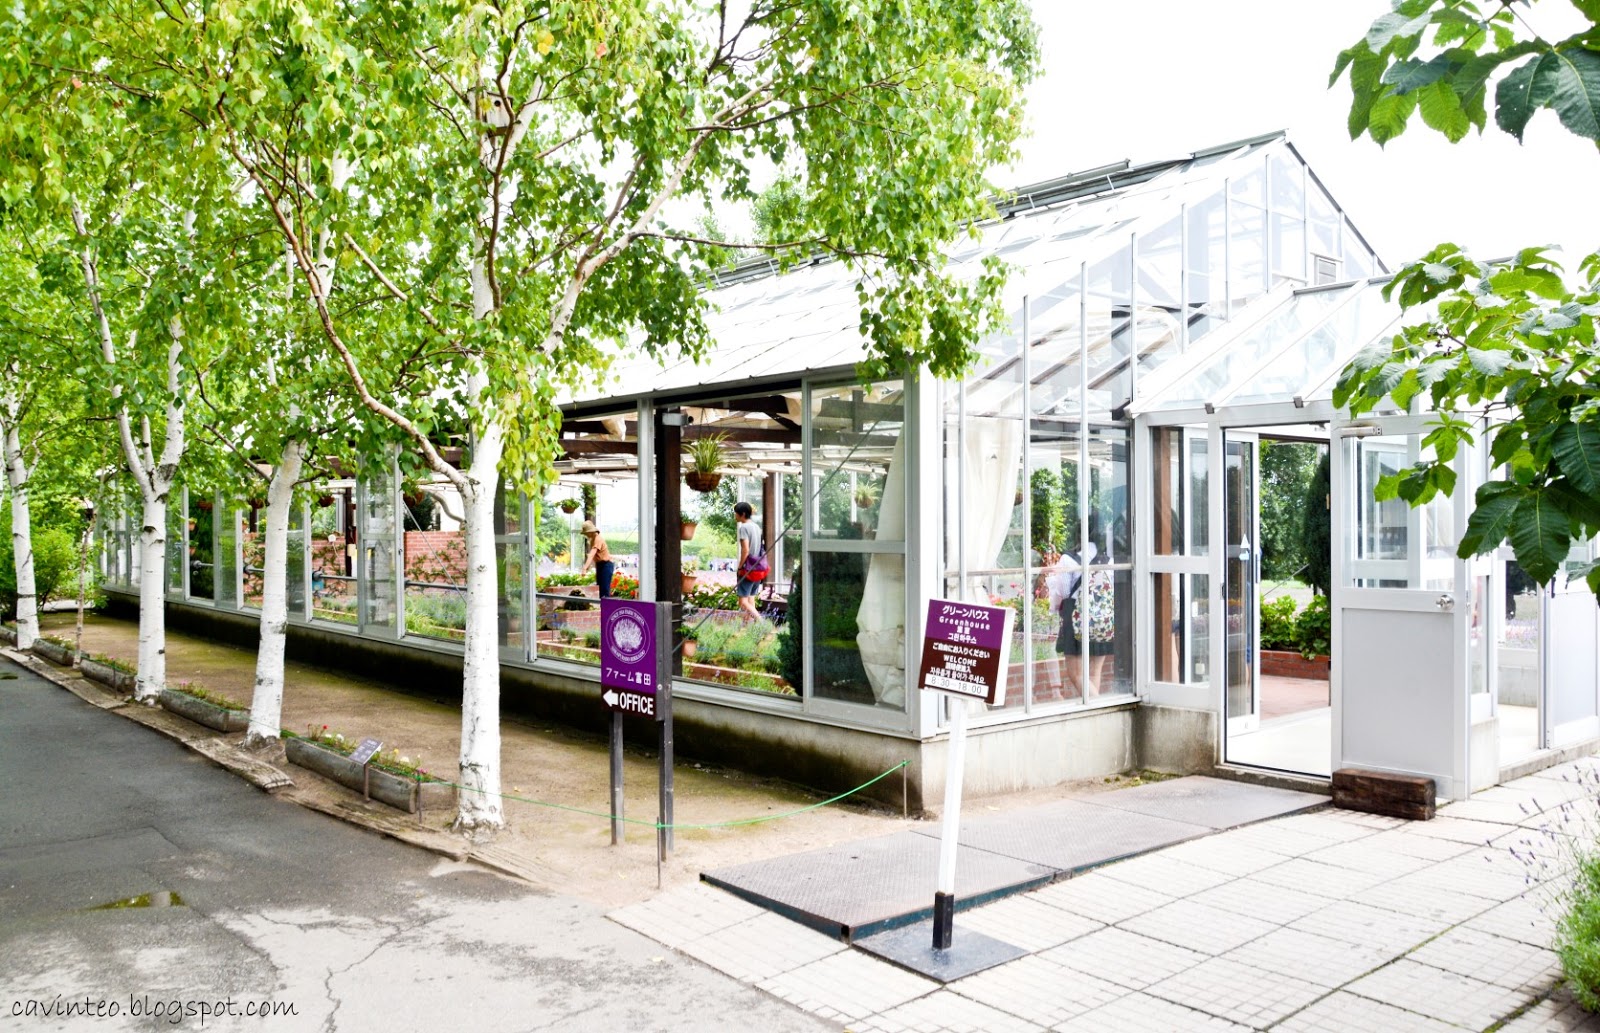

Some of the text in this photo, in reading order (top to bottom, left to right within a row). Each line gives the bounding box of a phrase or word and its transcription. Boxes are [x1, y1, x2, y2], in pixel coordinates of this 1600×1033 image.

[942, 605, 990, 621] グリーンハウス
[939, 616, 991, 630] Greenhouse
[943, 654, 977, 667] WELCOME
[605, 667, 651, 686] ファーム富田
[619, 691, 654, 716] OFFICE
